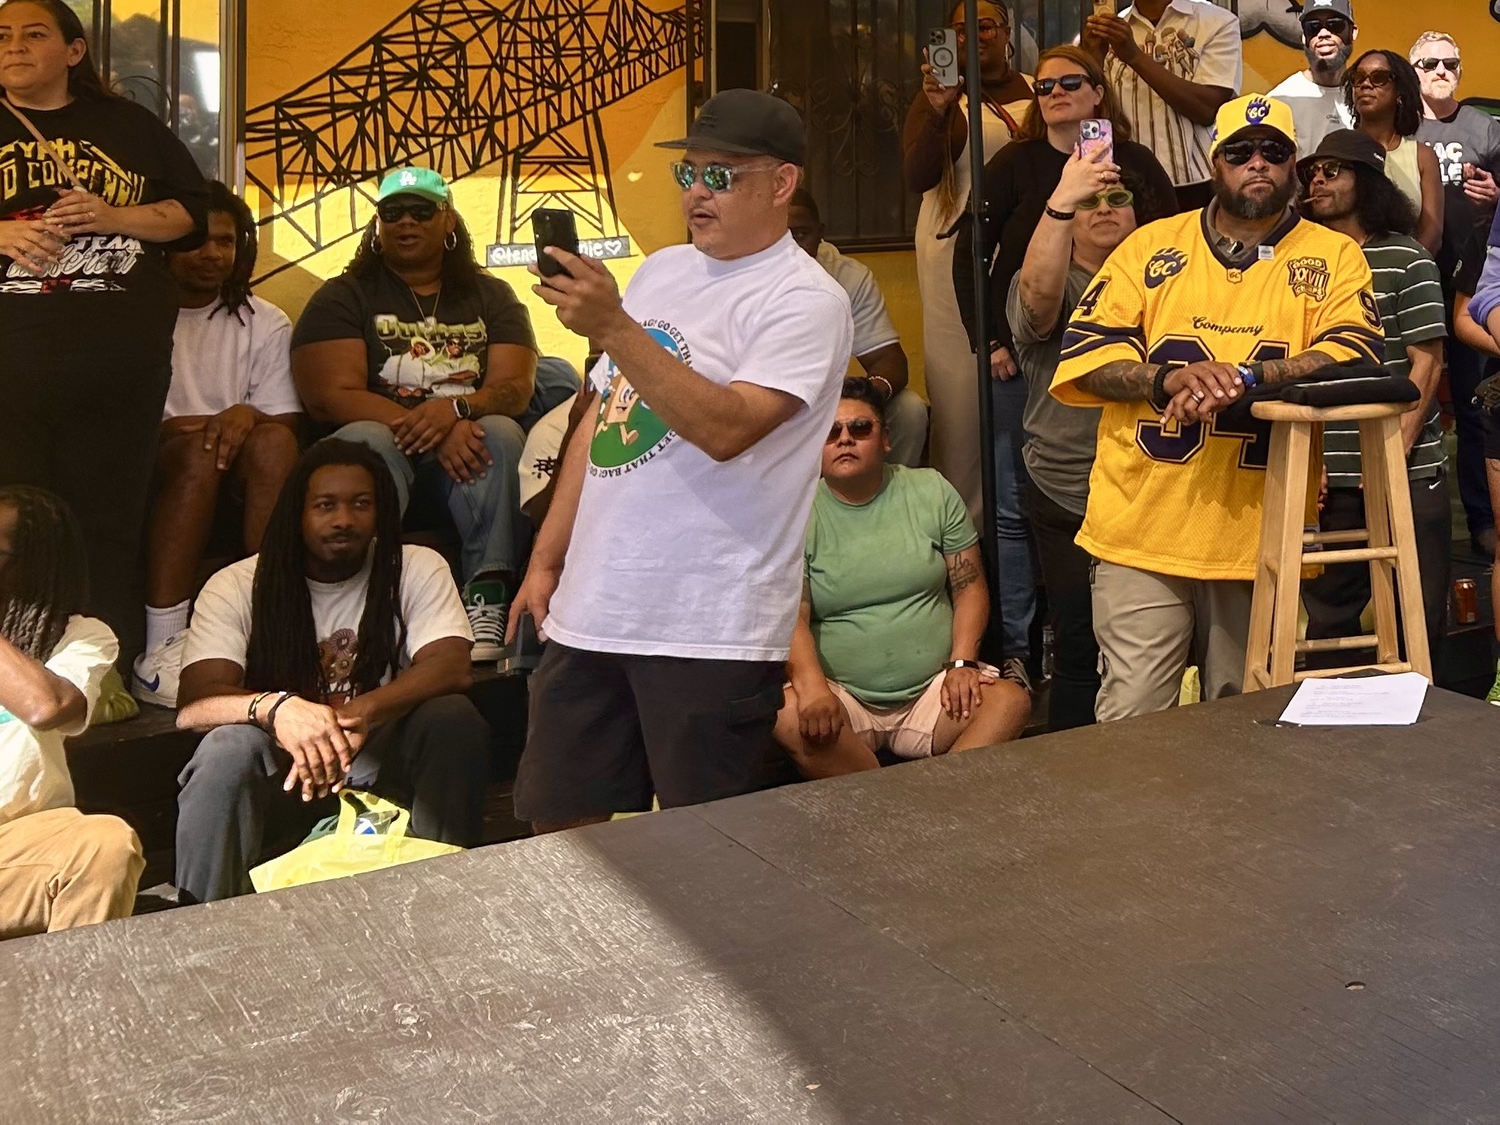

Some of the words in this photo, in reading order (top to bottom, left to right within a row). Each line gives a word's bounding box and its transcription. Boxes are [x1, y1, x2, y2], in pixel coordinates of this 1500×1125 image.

[1148, 258, 1178, 278] GC
[1293, 268, 1325, 288] XXVII
[658, 320, 671, 331] GO
[670, 326, 685, 343] GET
[1192, 314, 1265, 336] Compenny
[624, 451, 657, 474] THAT
